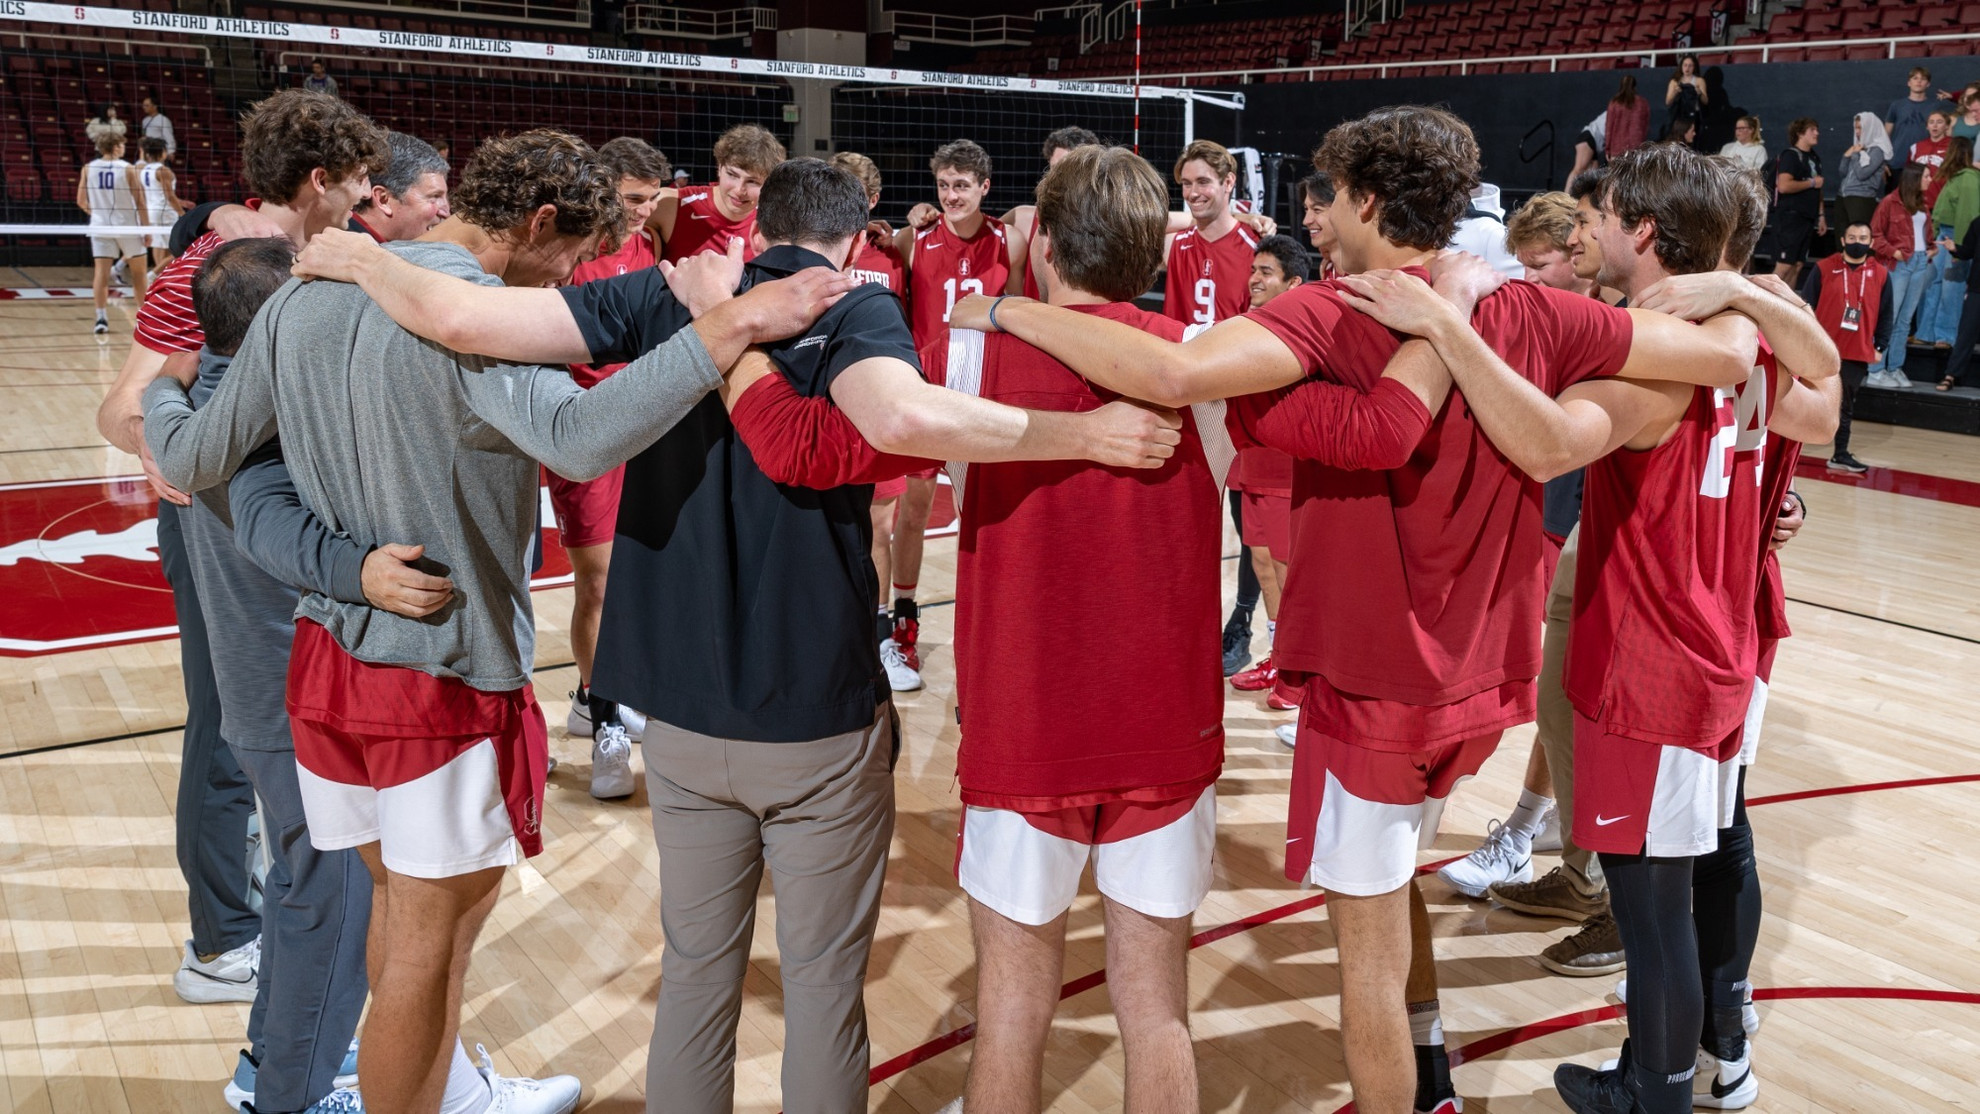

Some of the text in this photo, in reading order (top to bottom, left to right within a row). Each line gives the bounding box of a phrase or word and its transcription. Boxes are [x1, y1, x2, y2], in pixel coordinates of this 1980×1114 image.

[133, 12, 290, 36] STANFORD ATHLETICS
[379, 31, 512, 53] STANFORD ATHLETICS
[587, 48, 701, 67] STANFORD ATHLETICS
[767, 61, 866, 78] STANFORD ATHLETICS
[922, 72, 1009, 88] STANFORD ATHLETICS
[1057, 81, 1134, 96] STANFORD ATHLETICS
[98, 171, 115, 190] 10
[1193, 278, 1216, 323] 9
